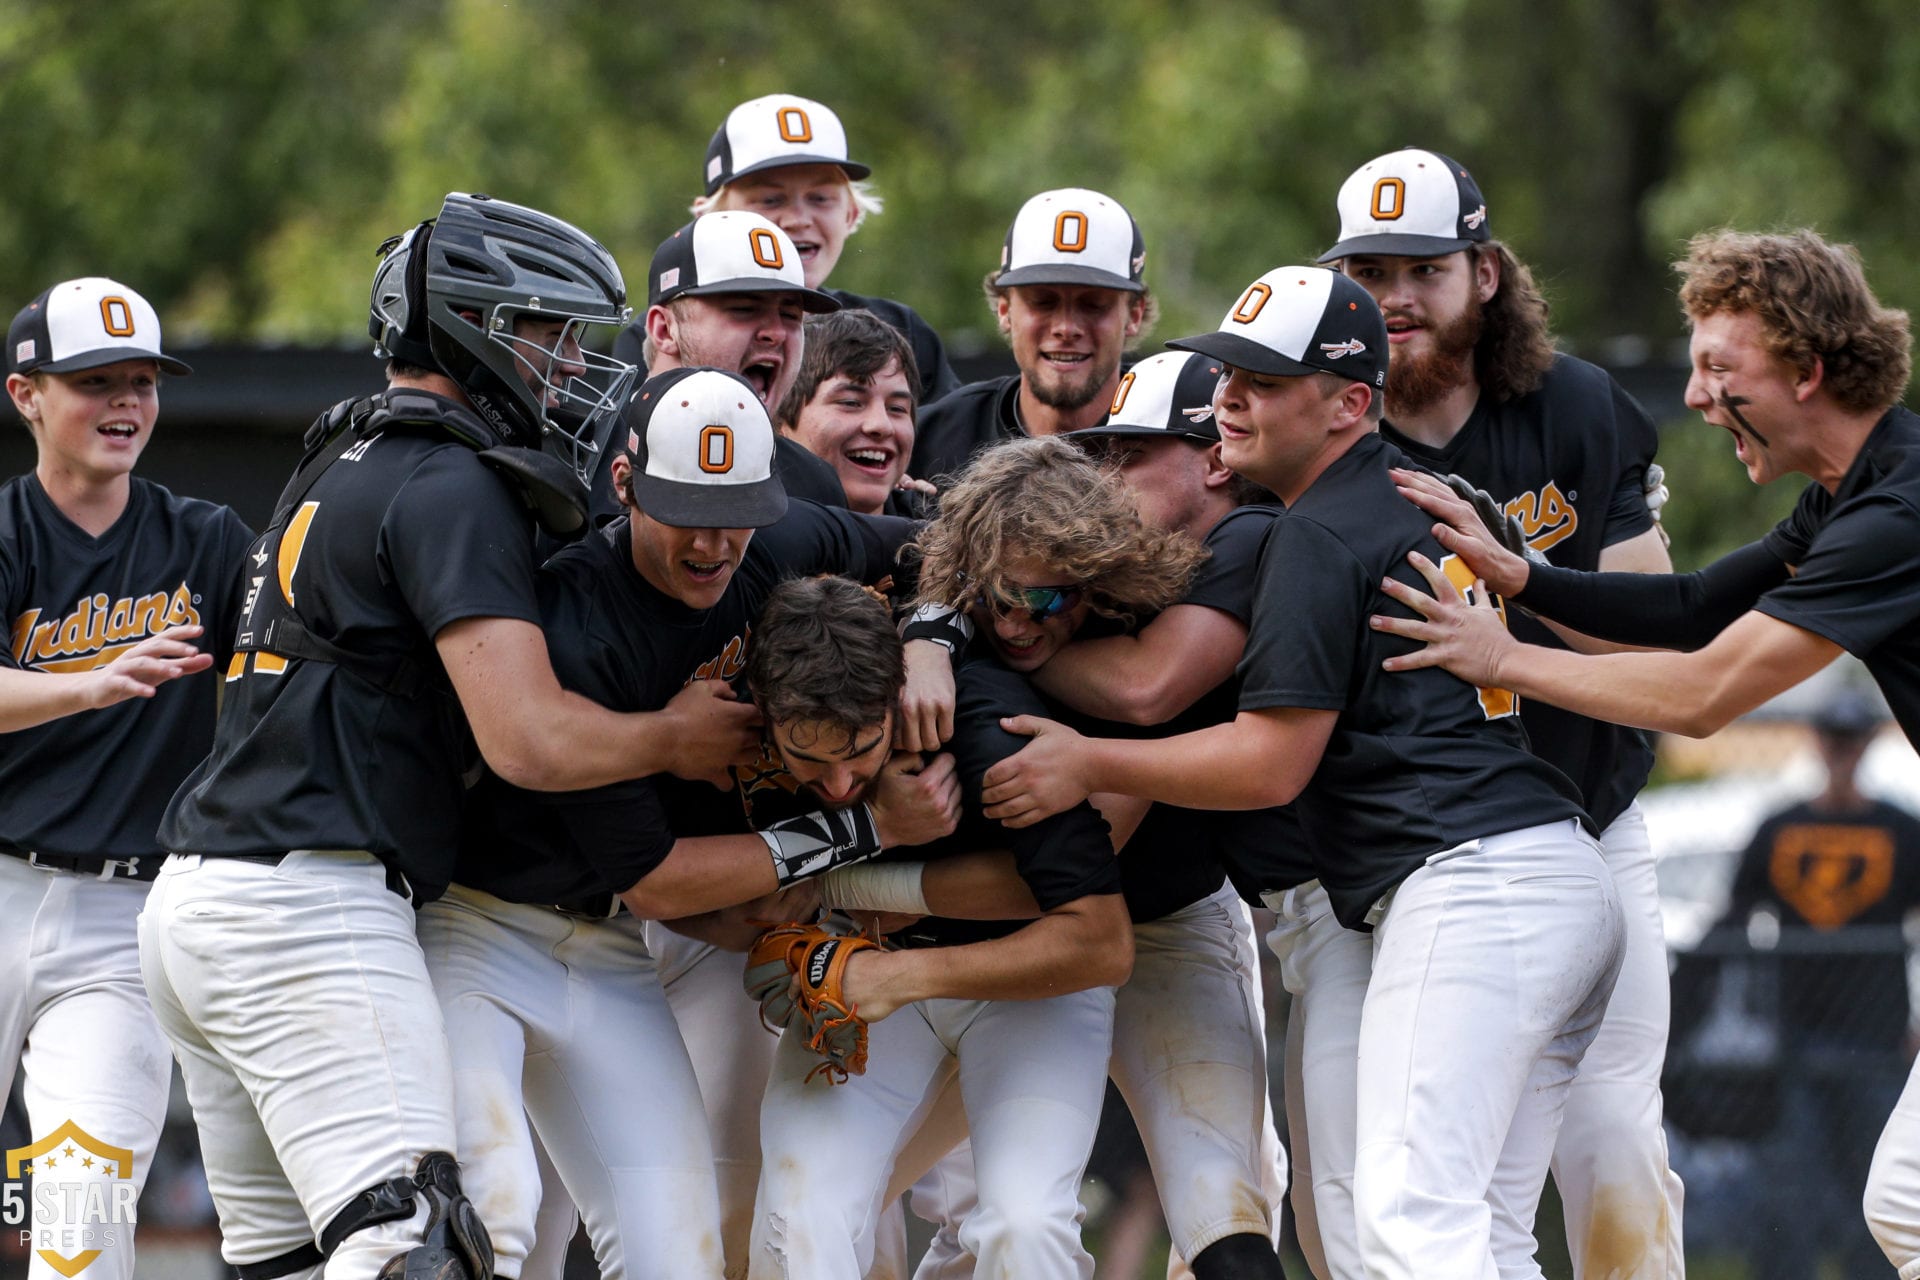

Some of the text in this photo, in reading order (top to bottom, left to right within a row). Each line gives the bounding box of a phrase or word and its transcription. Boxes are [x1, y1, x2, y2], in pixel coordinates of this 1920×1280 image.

[776, 106, 812, 143] O
[1370, 177, 1405, 221] O
[749, 228, 784, 270] O
[1053, 210, 1088, 253] O
[99, 296, 135, 337] O
[1232, 281, 1272, 325] O
[698, 424, 734, 474] O
[10, 580, 201, 670] Indians
